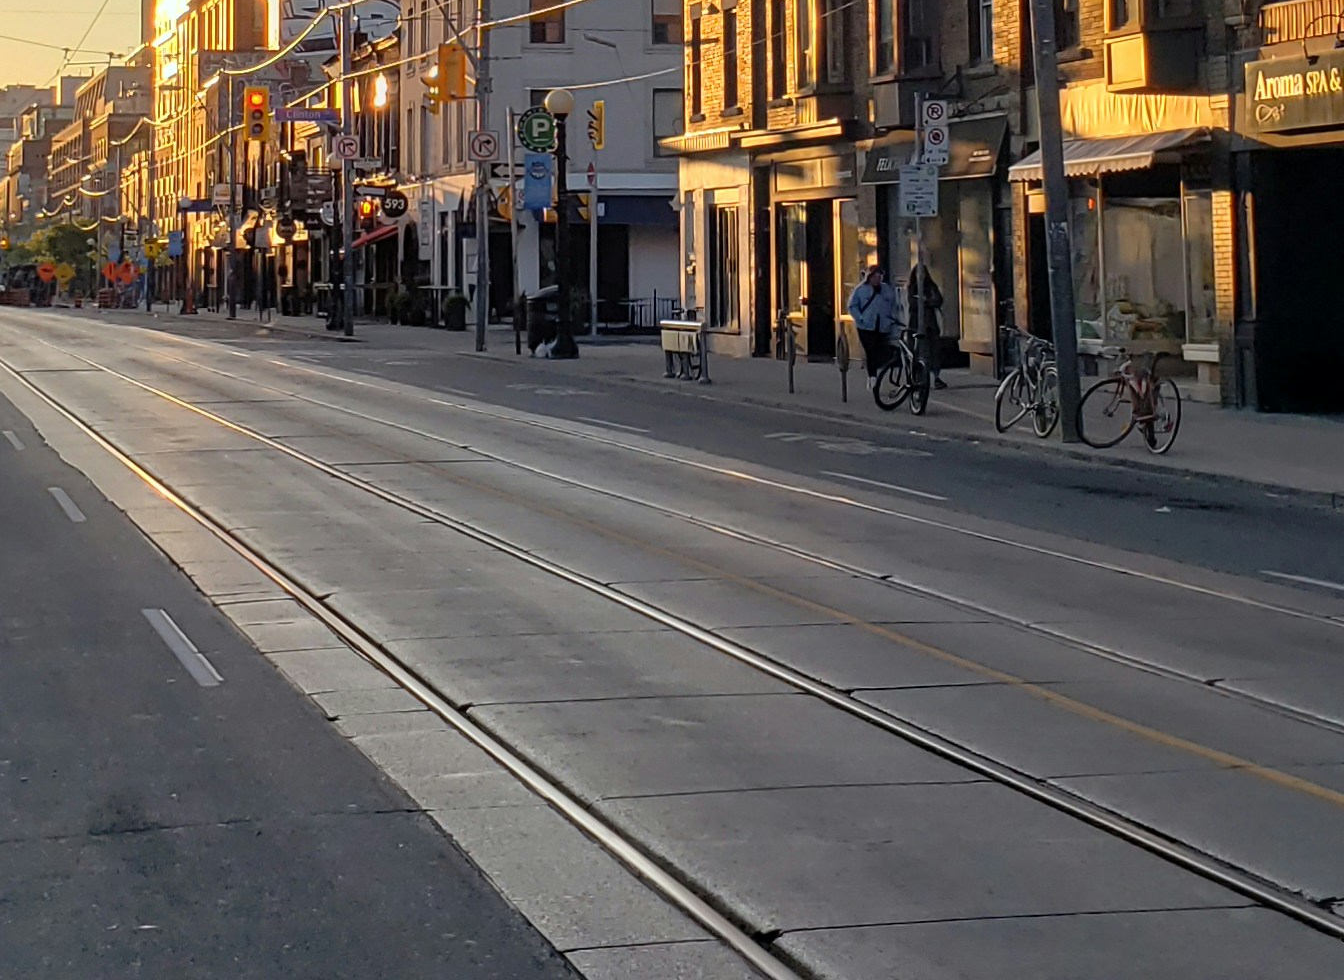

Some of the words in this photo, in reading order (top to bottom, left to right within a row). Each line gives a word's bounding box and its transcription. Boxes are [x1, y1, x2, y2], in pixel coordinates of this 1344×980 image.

[1254, 70, 1303, 101] Aroma
[1306, 70, 1329, 95] SPA
[1329, 67, 1342, 91] &
[286, 109, 321, 119] Clinton
[532, 118, 550, 137] P
[384, 199, 405, 210] 593
